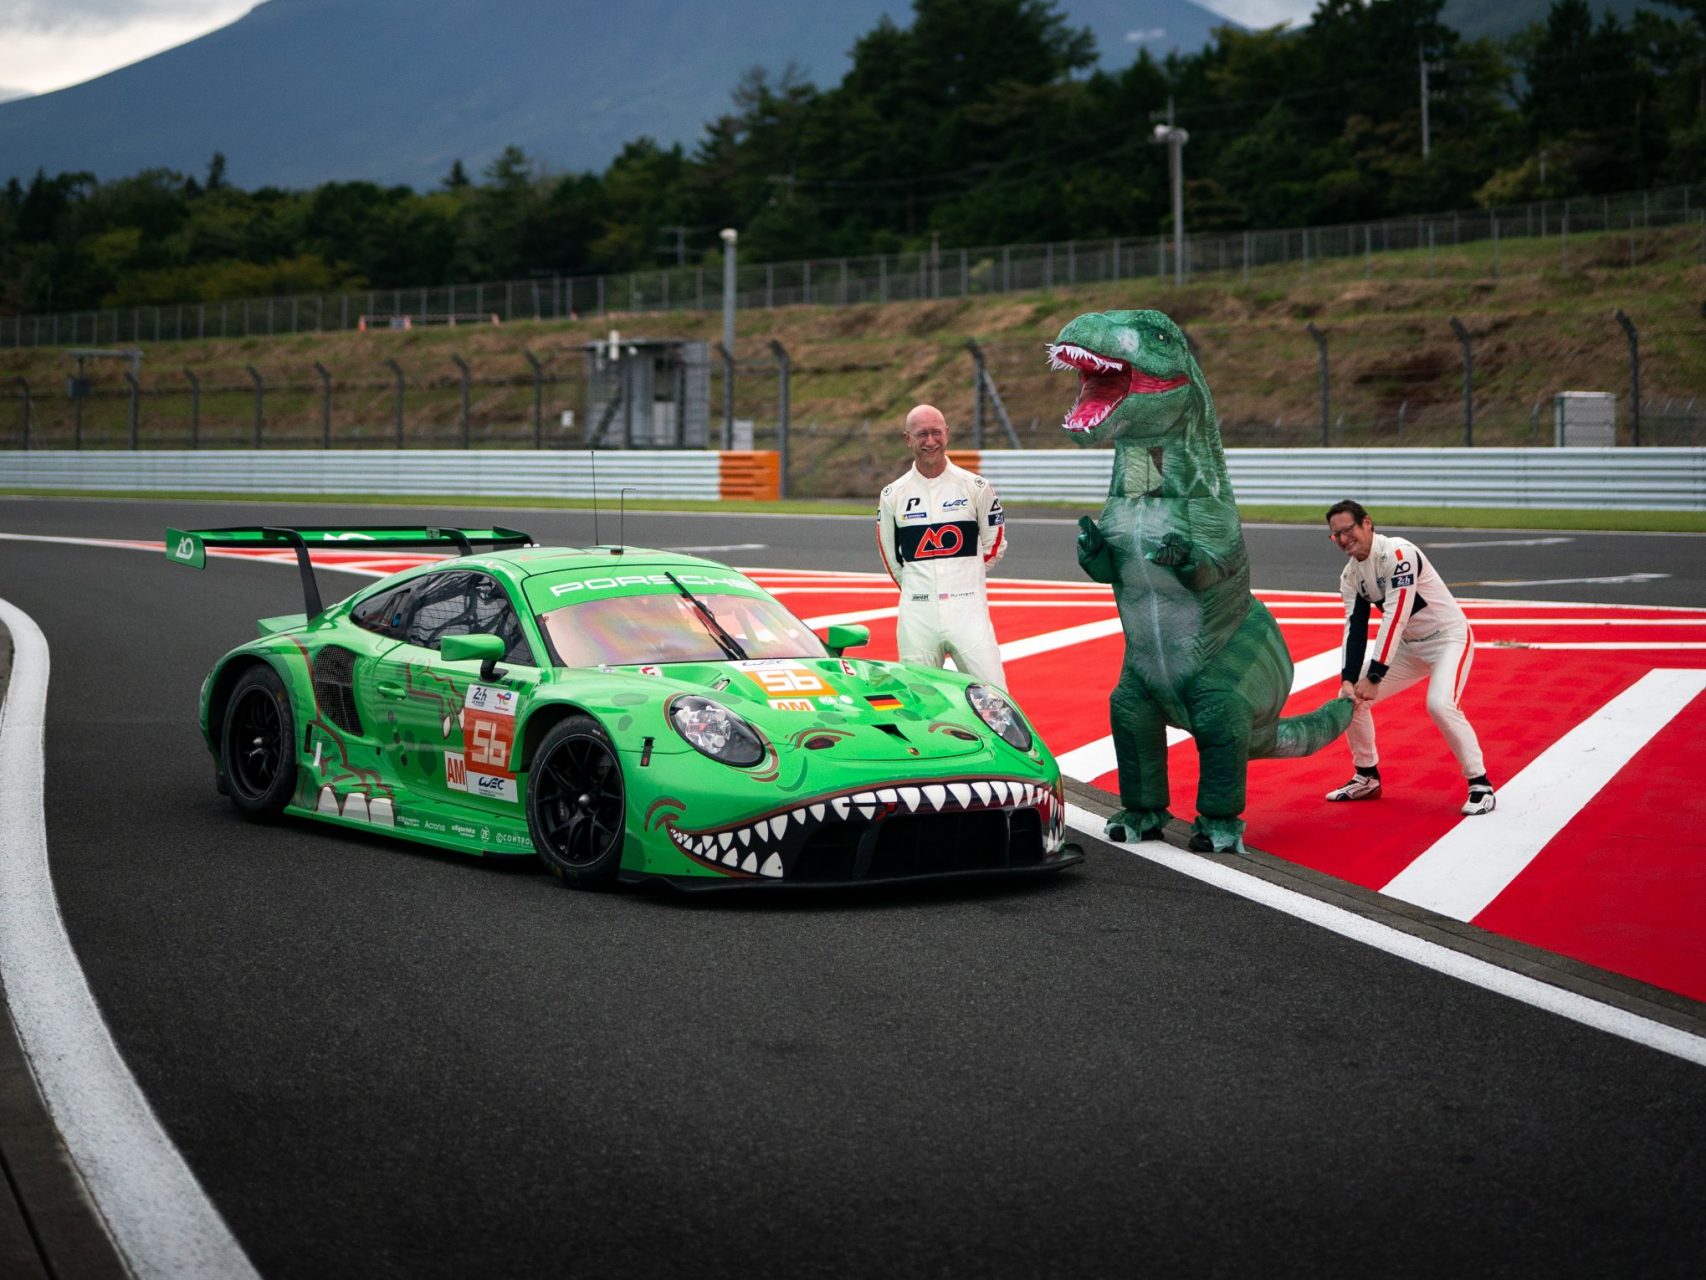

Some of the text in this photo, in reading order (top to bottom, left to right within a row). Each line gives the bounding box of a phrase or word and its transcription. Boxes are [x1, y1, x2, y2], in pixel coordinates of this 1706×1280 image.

[943, 499, 968, 507] WEC
[914, 524, 963, 559] AO
[1394, 561, 1411, 576] AO
[550, 575, 758, 597] PORSCHE
[756, 669, 824, 692] 56
[777, 701, 811, 711] AM
[472, 720, 507, 767] 56
[447, 757, 466, 786] AM
[479, 776, 505, 791] WEC
